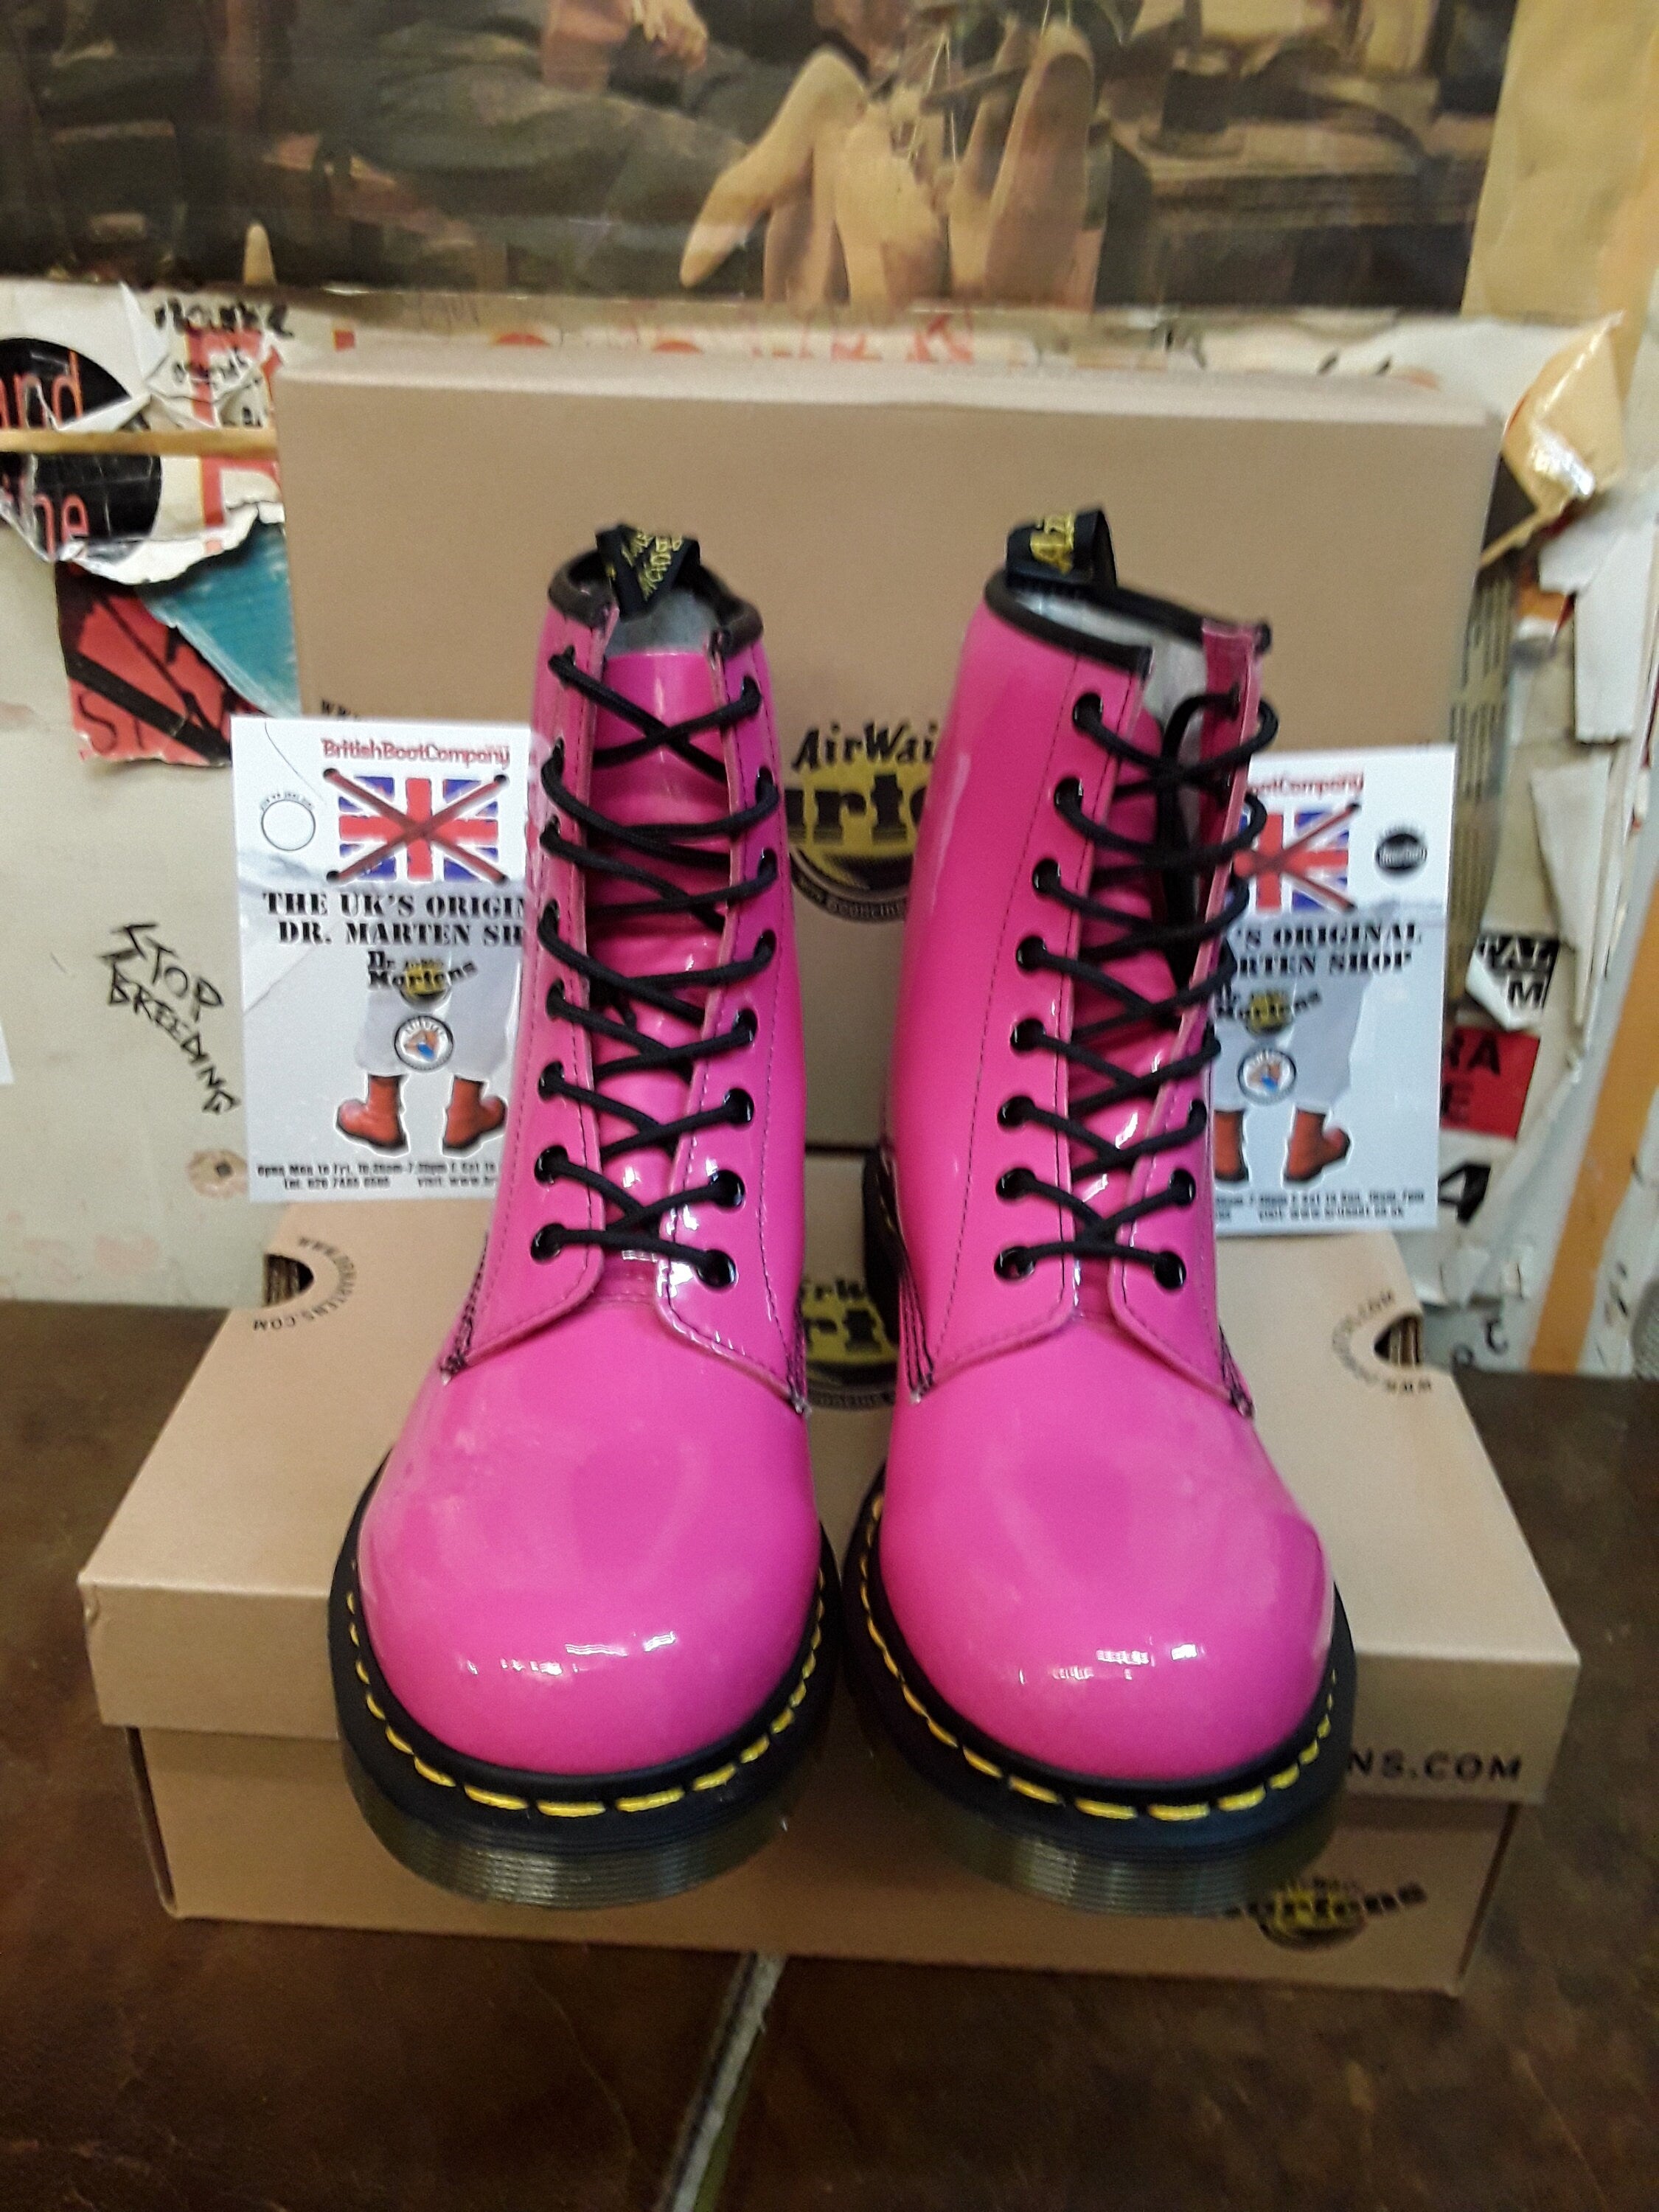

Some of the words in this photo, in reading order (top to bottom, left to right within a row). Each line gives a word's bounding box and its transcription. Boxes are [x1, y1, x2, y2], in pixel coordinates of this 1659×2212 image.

[263, 892, 327, 915] THE
[341, 894, 415, 918] UK'S
[279, 921, 333, 945] DR.
[346, 922, 472, 945] MARTEN
[1273, 922, 1422, 945] ORIGINAL
